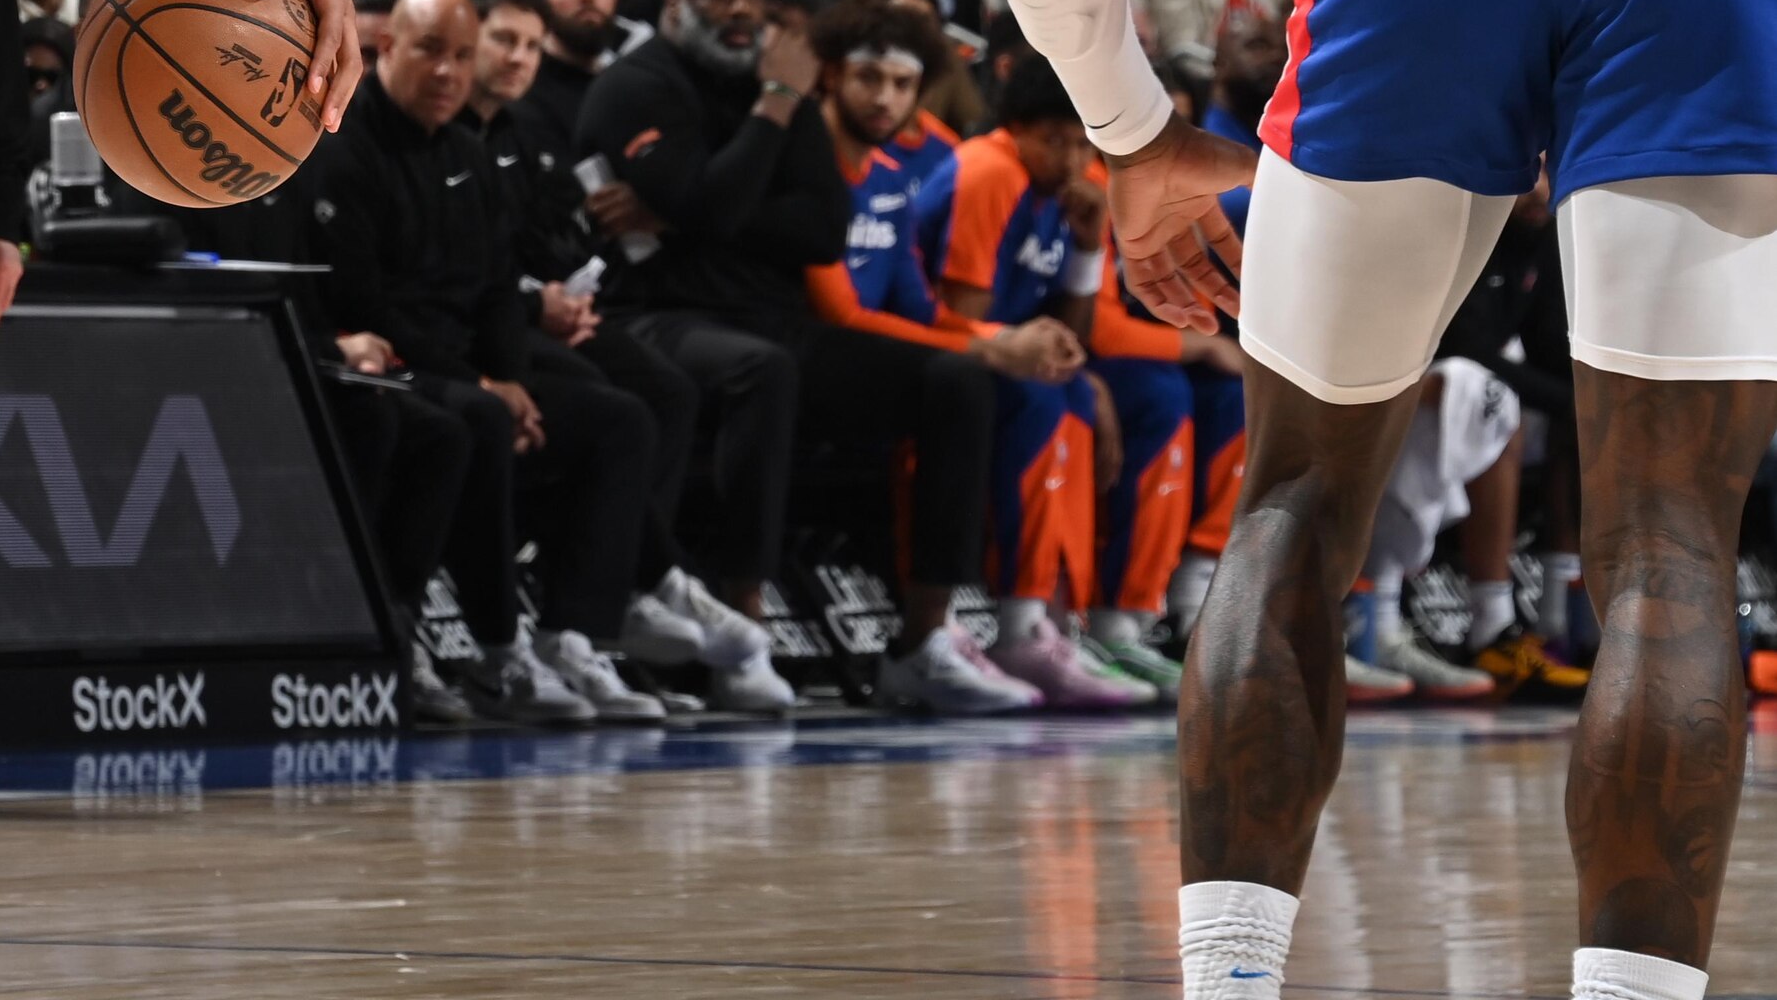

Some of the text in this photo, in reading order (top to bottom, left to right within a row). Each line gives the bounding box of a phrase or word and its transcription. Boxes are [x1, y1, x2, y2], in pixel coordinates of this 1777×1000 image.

[159, 88, 281, 198] Wilson
[72, 670, 207, 732] StockX
[271, 670, 399, 729] StockX
